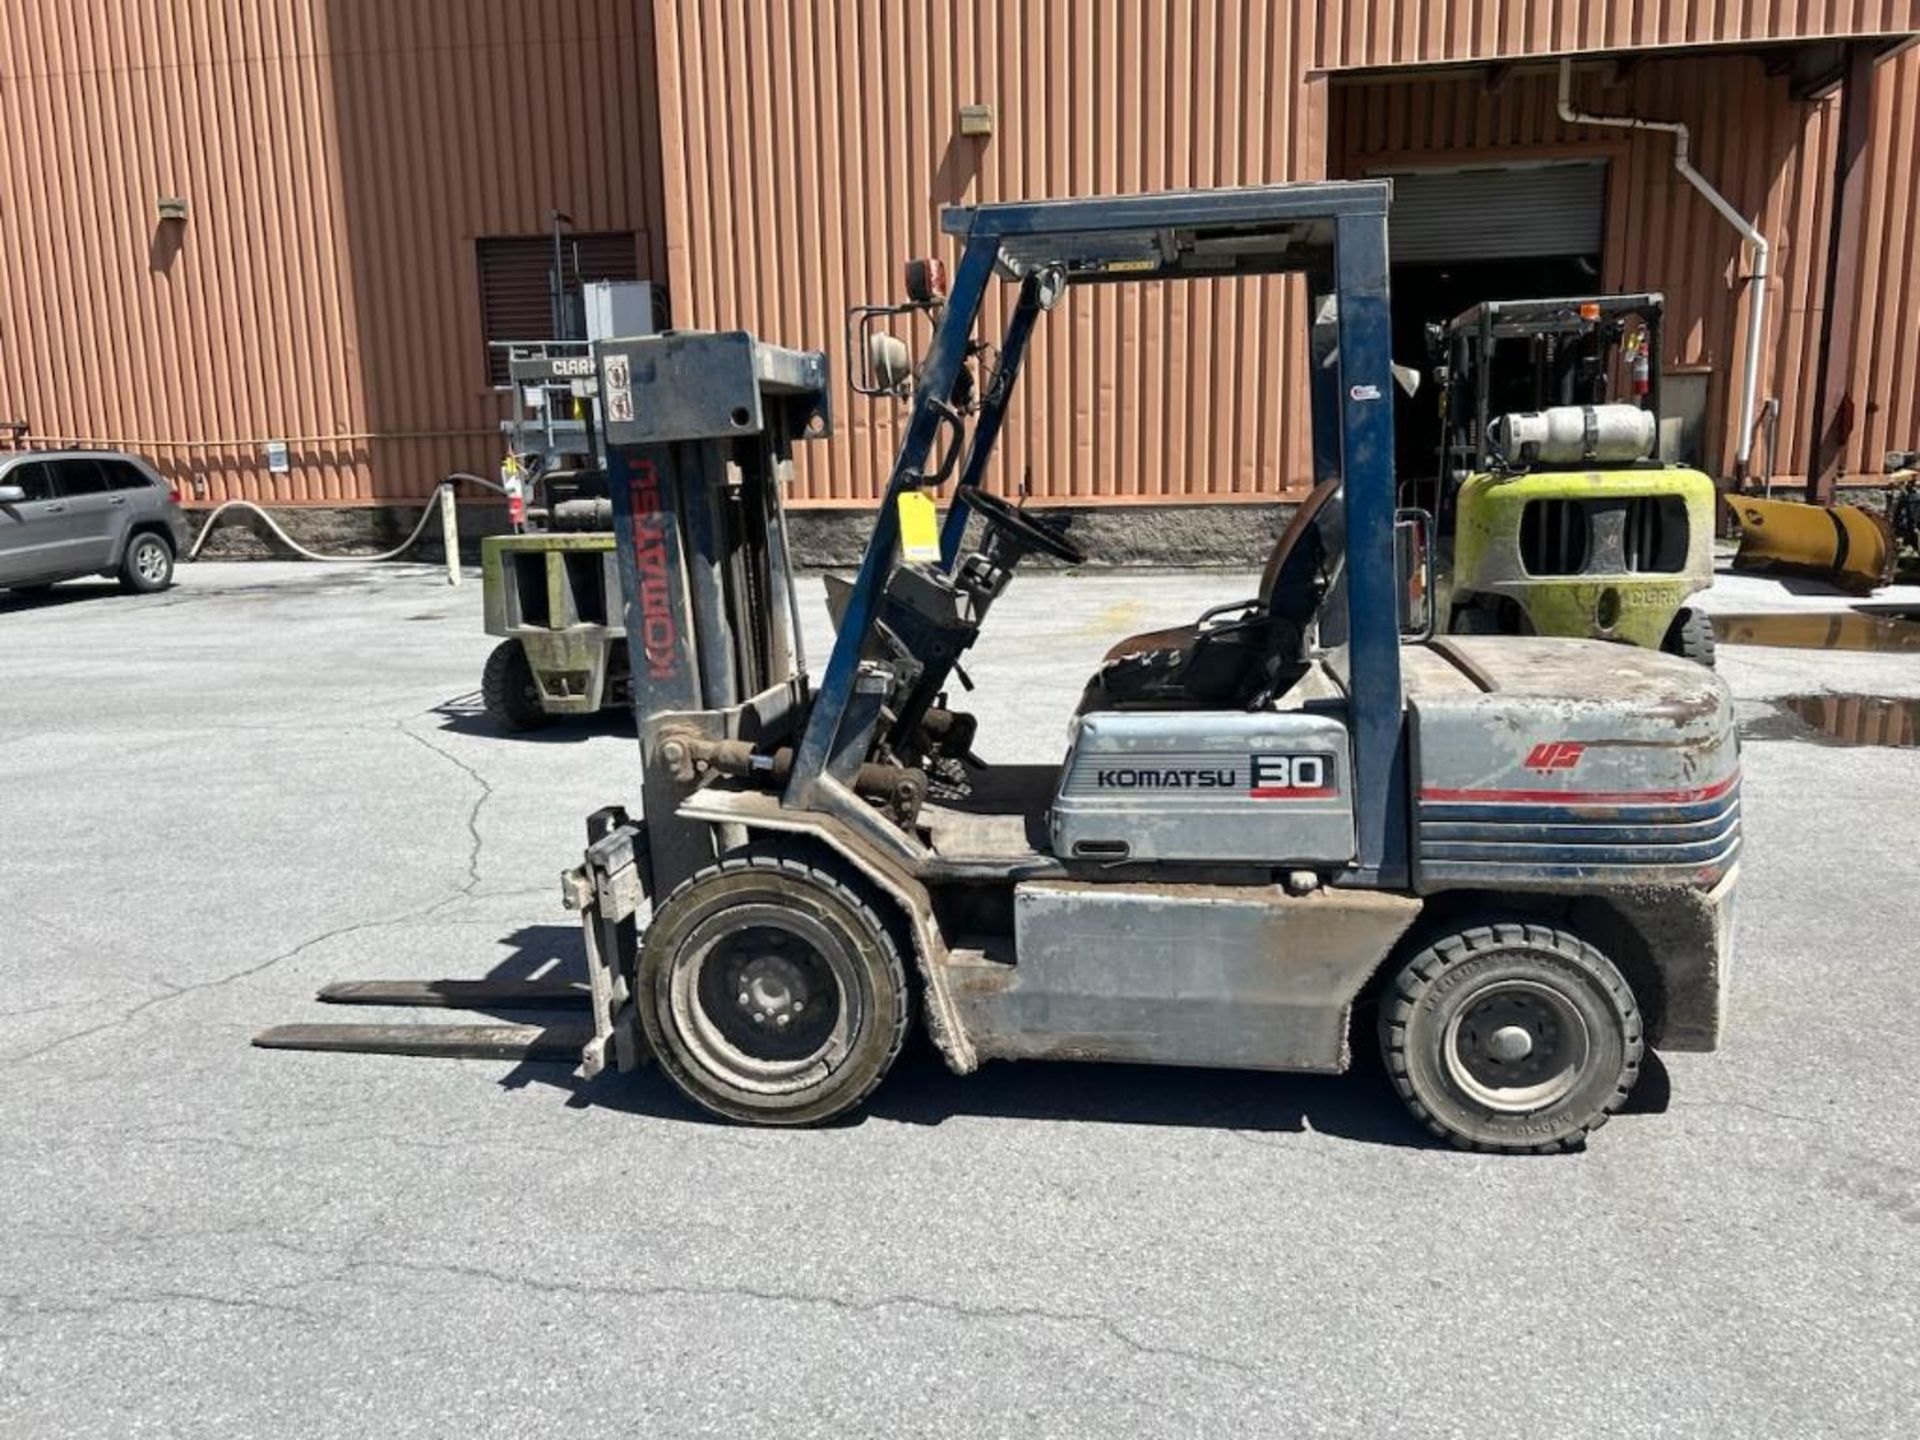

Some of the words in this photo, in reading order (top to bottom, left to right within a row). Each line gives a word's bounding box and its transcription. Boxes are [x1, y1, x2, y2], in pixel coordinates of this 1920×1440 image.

[628, 458, 677, 681] KOMATSU
[1631, 588, 1678, 608] CLARK
[1097, 770, 1236, 788] KOMATSU
[1257, 756, 1324, 788] 30
